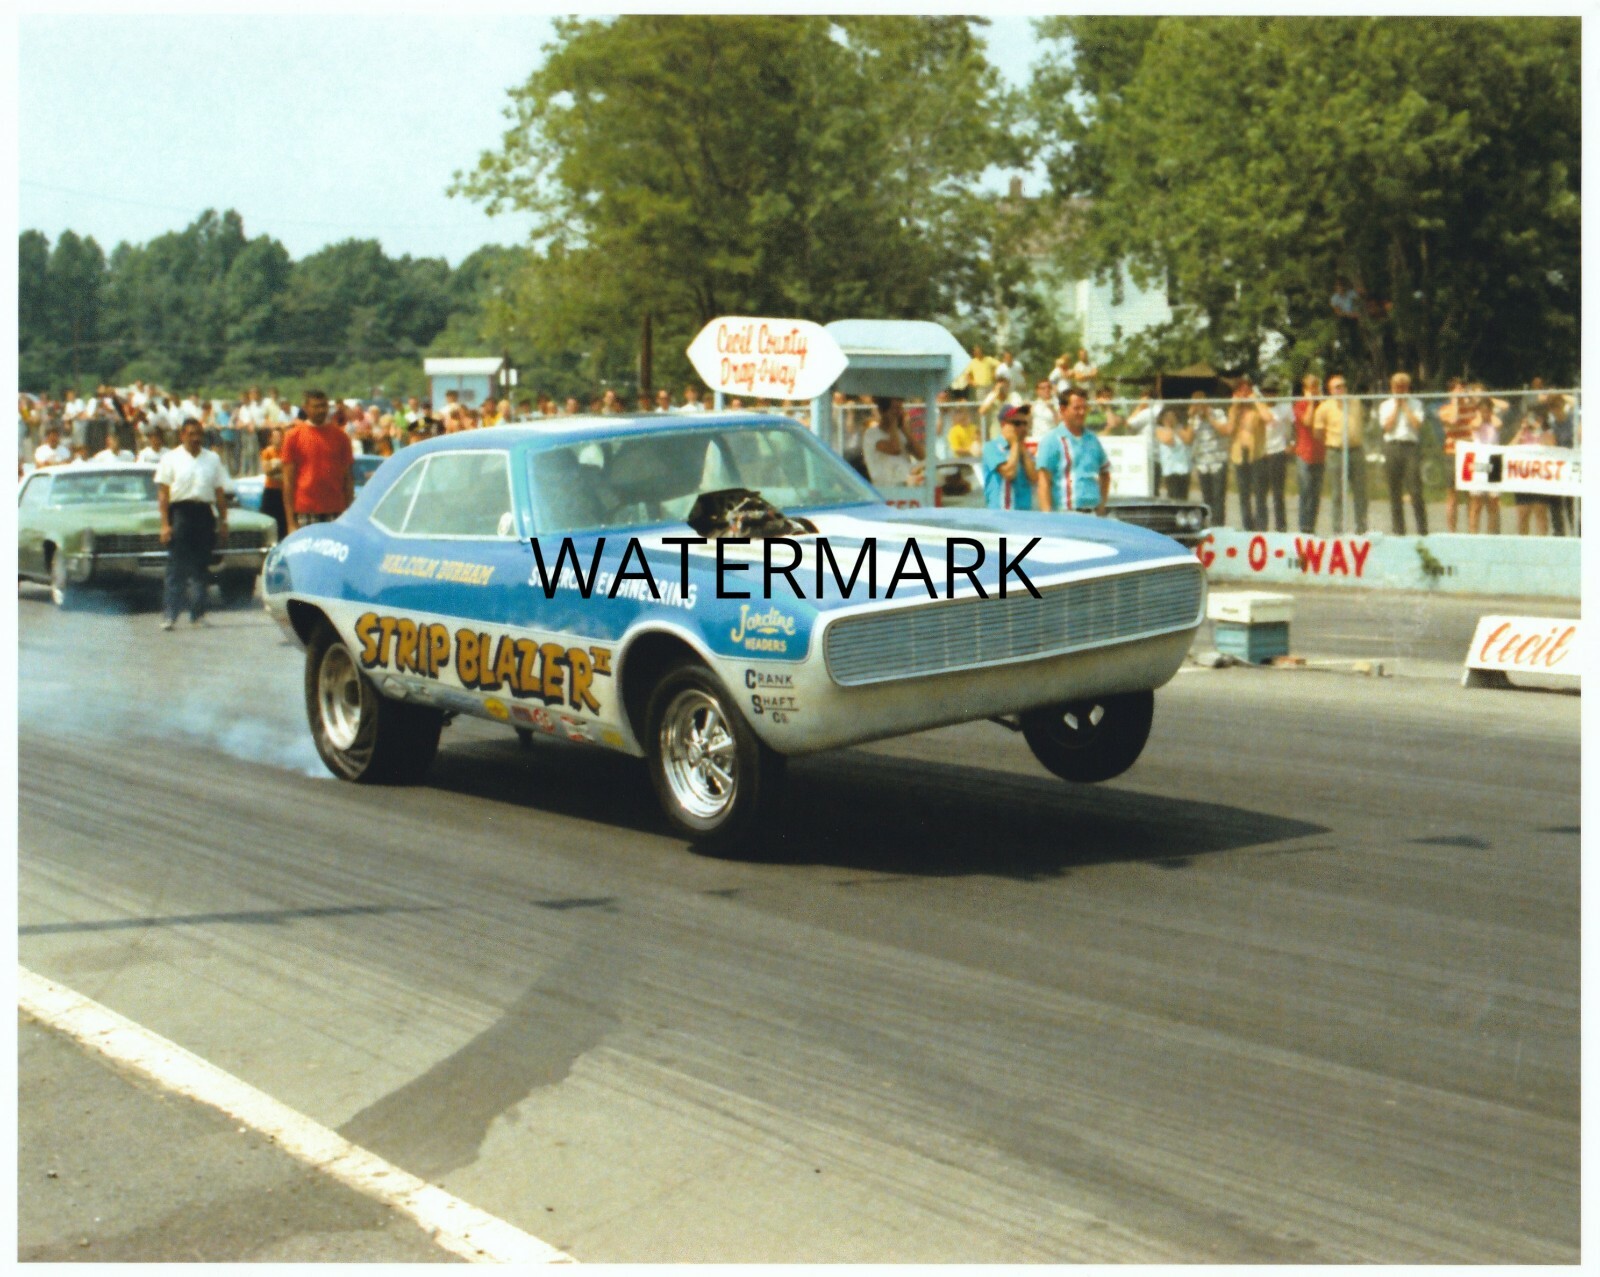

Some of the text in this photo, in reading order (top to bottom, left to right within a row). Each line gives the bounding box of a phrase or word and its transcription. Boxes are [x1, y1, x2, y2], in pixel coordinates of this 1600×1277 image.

[716, 323, 808, 369] Cecil County
[1507, 460, 1567, 481] HURST
[355, 612, 451, 680] STRIP
[455, 627, 602, 716] BLAZER
[745, 638, 787, 653] HEADERS
[1480, 622, 1576, 667] Cecil
